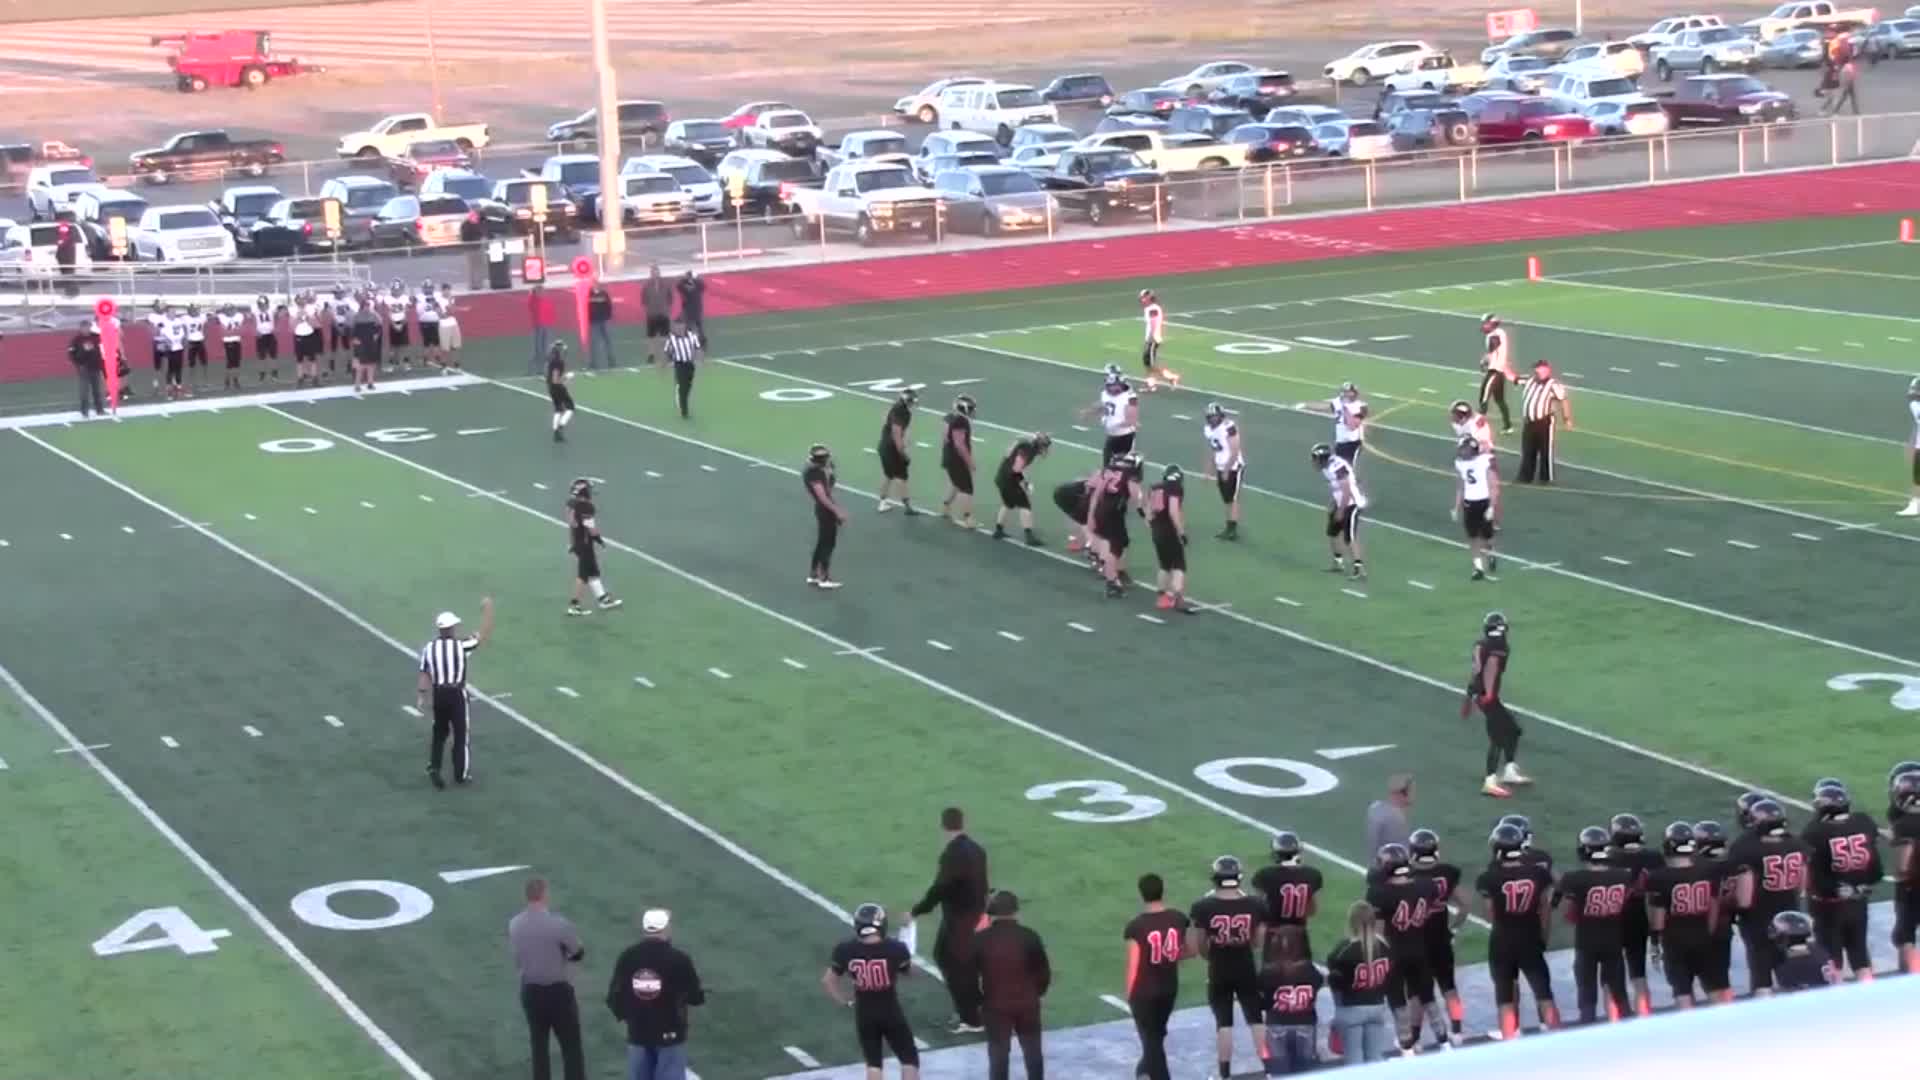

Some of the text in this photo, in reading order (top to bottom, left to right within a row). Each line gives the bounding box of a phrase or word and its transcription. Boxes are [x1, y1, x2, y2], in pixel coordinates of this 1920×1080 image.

[1466, 469, 1477, 484] 5
[1829, 834, 1870, 871] 55
[1762, 851, 1807, 892] 56
[1280, 883, 1309, 918] 11
[1502, 879, 1535, 913] 17
[1671, 881, 1711, 914] 80
[1211, 914, 1253, 945] 33
[1392, 897, 1430, 931] 44
[1148, 928, 1180, 964] 14
[848, 959, 890, 992] 30
